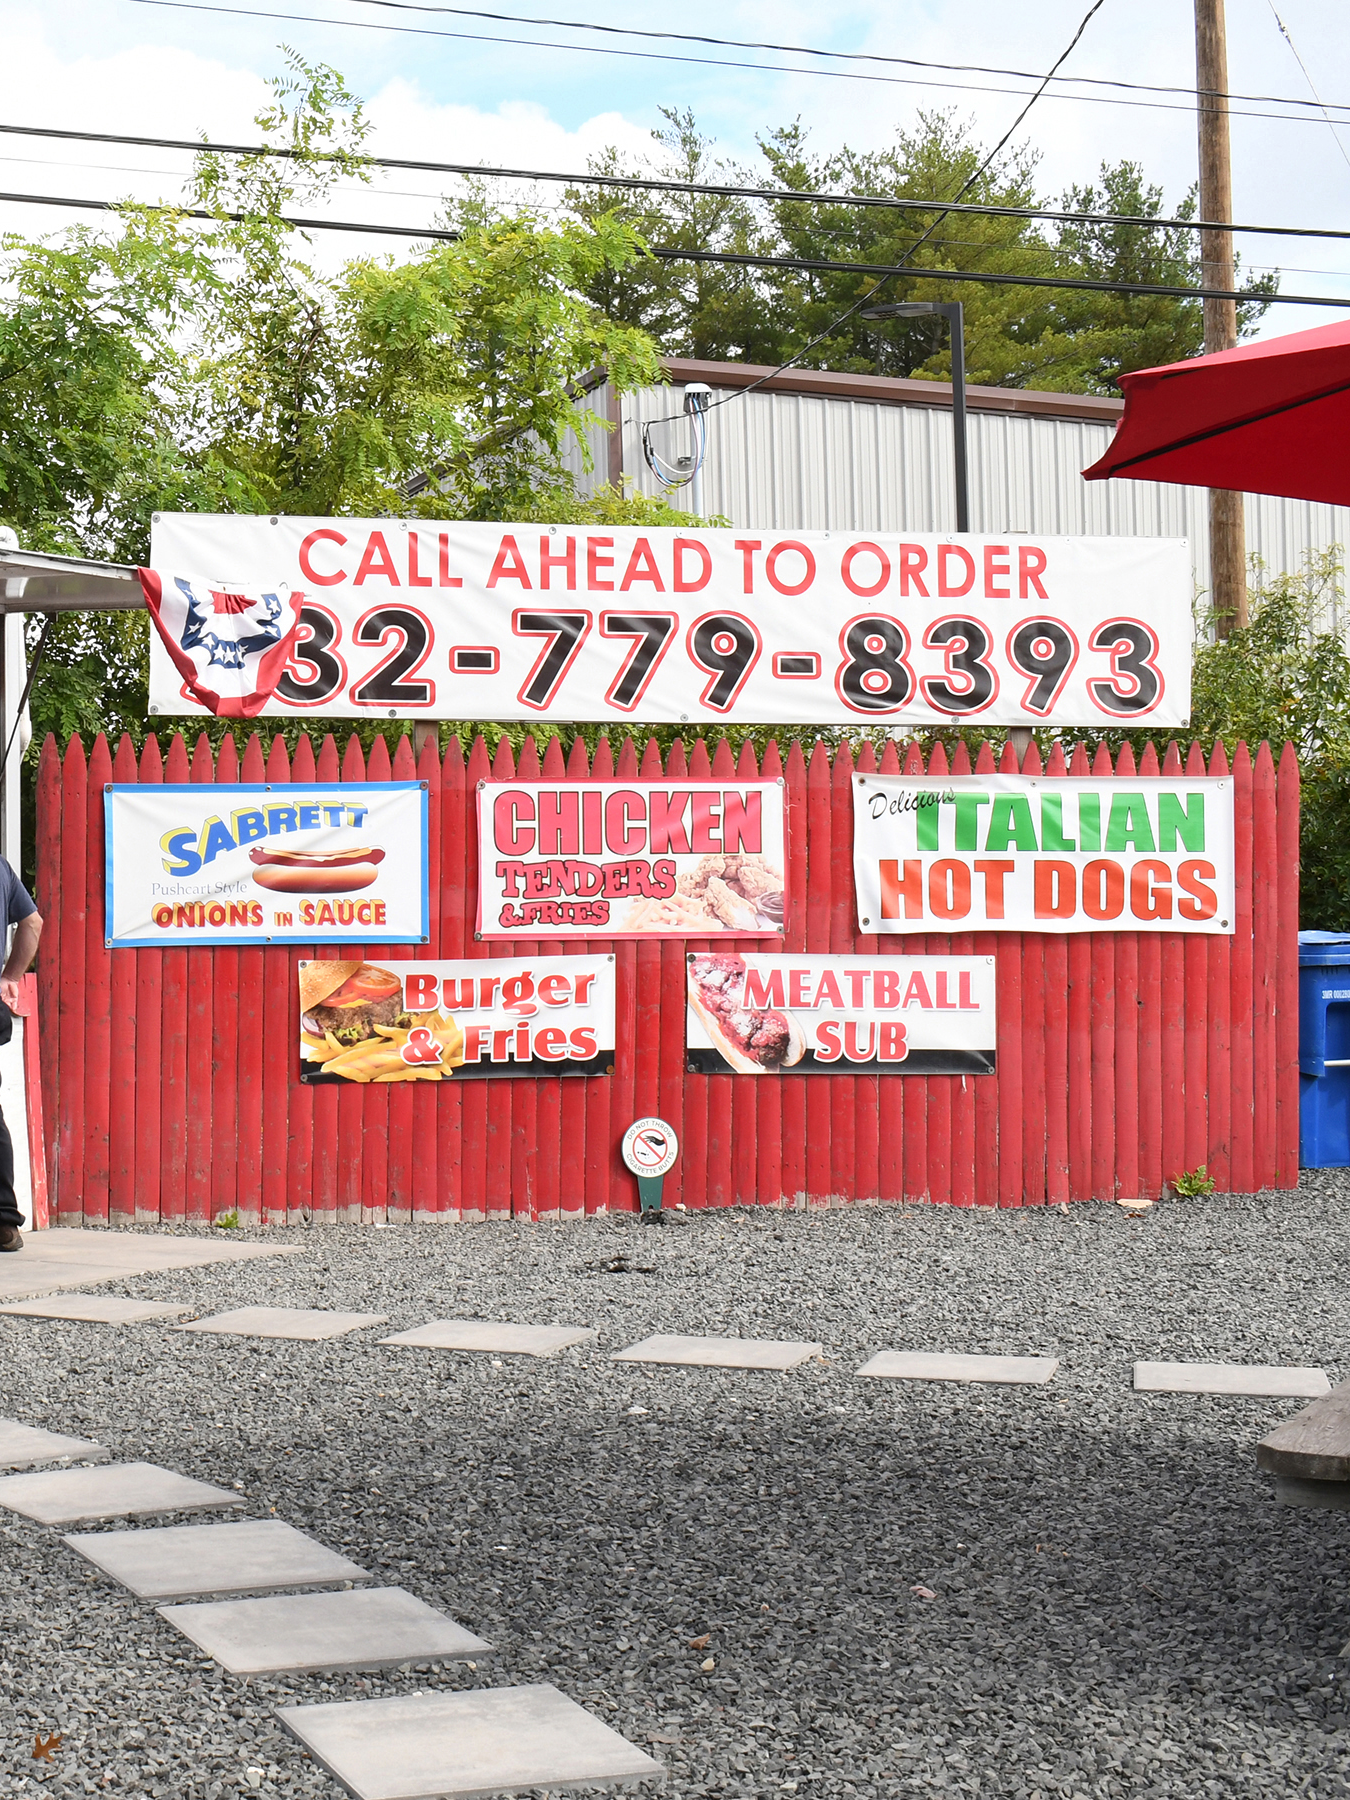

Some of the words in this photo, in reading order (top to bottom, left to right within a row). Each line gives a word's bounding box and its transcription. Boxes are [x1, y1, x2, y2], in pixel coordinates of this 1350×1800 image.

[298, 528, 463, 590] CALL
[485, 533, 713, 594] AHEAD
[734, 539, 817, 596] TO
[841, 540, 1050, 600] ORDER
[180, 602, 1165, 719] 32-779-8393
[493, 789, 762, 856] CHICKEN
[868, 786, 957, 820] Delicious
[916, 792, 1205, 853] ITALIAN
[159, 800, 369, 878] SABRETT
[151, 881, 211, 896] Pushcart
[214, 880, 248, 897] Style
[495, 859, 677, 900] TENDERS
[878, 858, 1015, 921] HOT
[1034, 858, 1218, 921] DOGS
[151, 900, 263, 928] ONIONS
[274, 911, 293, 927] IN
[299, 899, 386, 926] SAUCE
[405, 970, 597, 1016] Burger
[742, 968, 981, 1009] MEATBALL
[401, 1027, 443, 1065] &
[464, 1021, 598, 1062] Fries
[814, 1021, 908, 1061] SUB
[627, 1129, 636, 1140] DO
[635, 1120, 650, 1131] NOT
[652, 1120, 674, 1138] THROW
[626, 1153, 657, 1174] CIGARETTE
[658, 1151, 674, 1171] BUTTS
